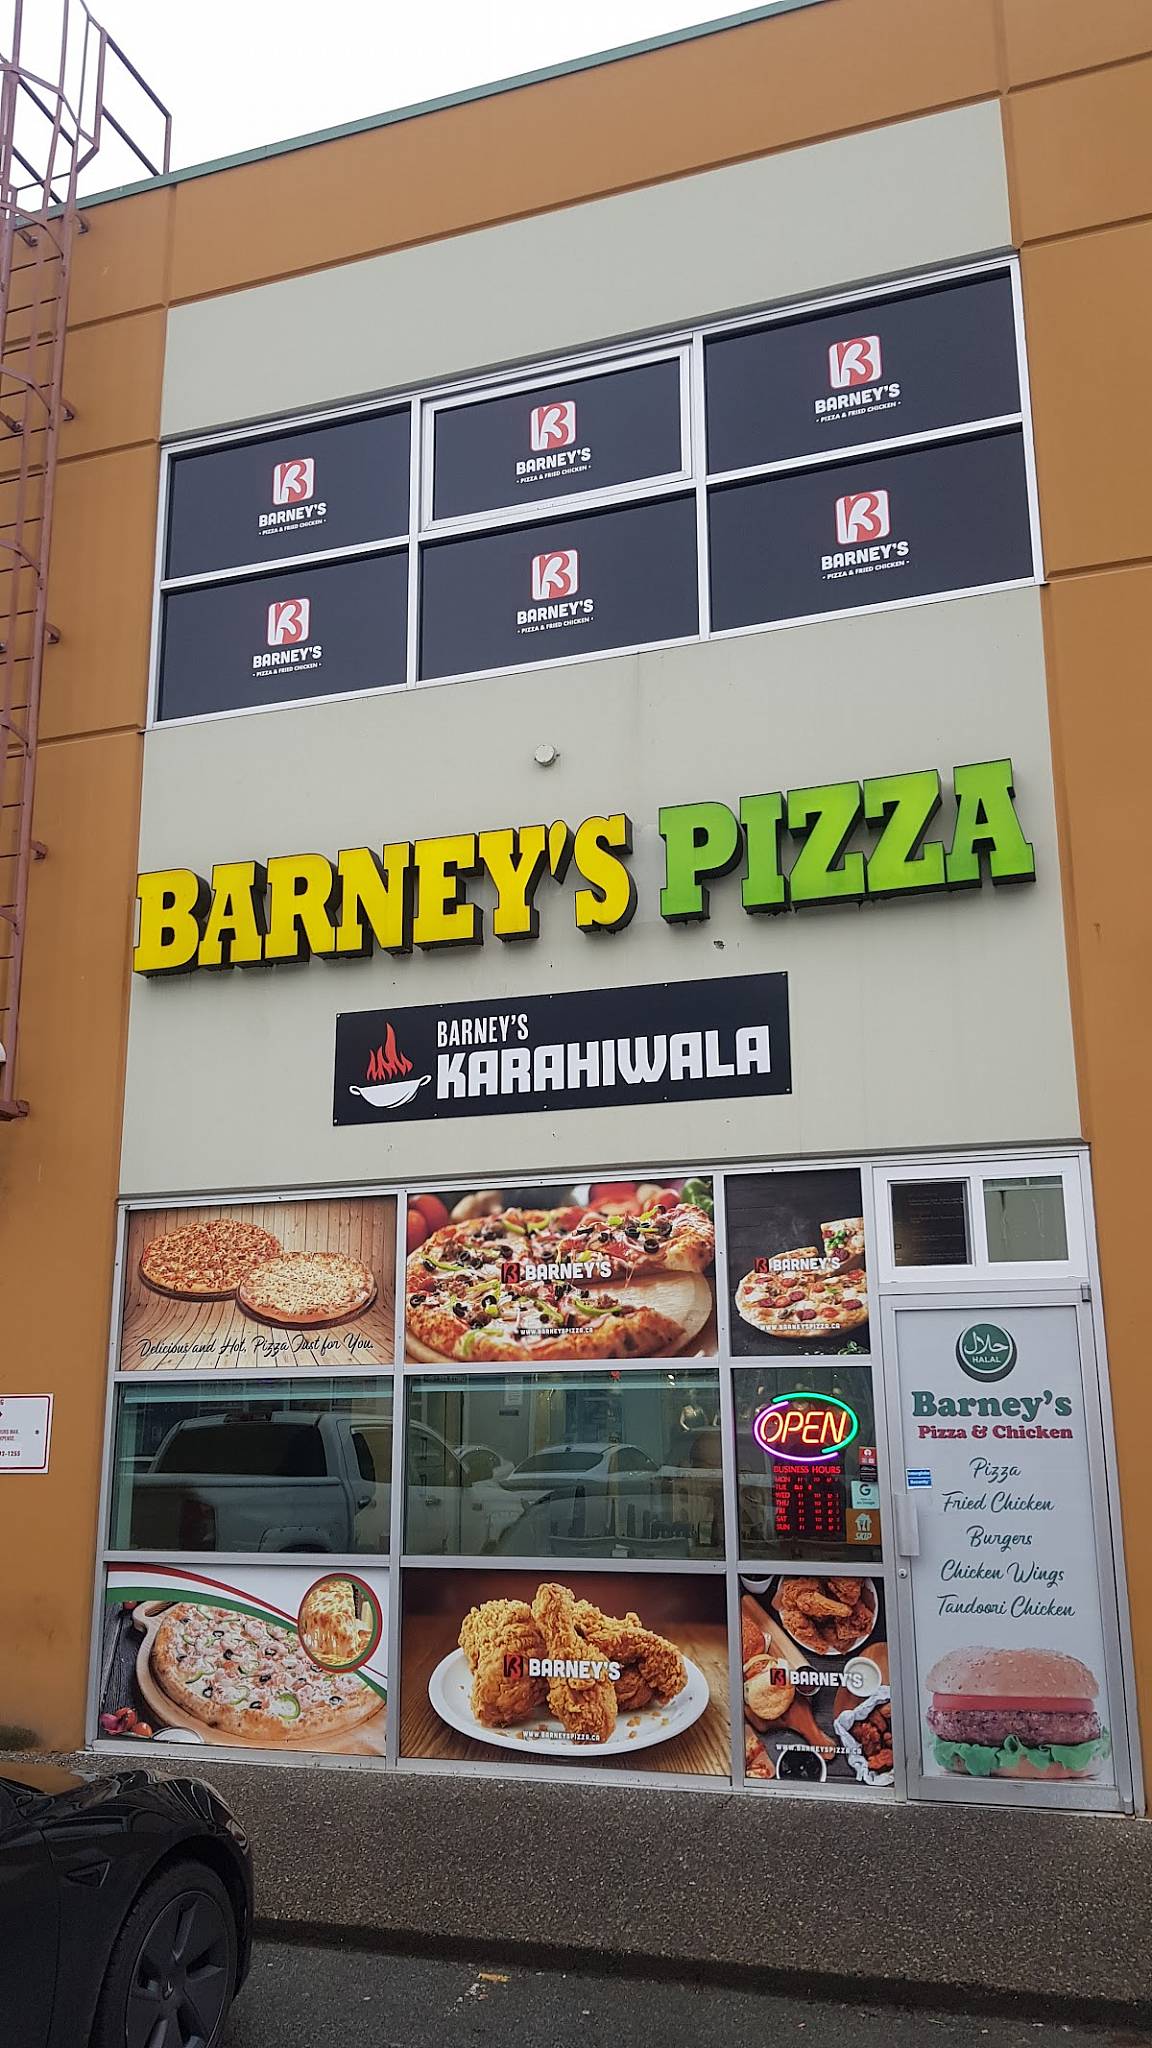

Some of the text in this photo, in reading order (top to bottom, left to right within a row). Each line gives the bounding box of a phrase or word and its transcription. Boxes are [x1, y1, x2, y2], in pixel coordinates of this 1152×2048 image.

[814, 383, 901, 414] BARNEY'S
[820, 414, 840, 423] PIZZA
[847, 408, 866, 417] FRIED
[866, 402, 896, 412] CHICKEN
[516, 447, 591, 475] BARNEY'S
[520, 476, 538, 484] PIZZA
[561, 465, 588, 475] CHICKEN
[258, 502, 327, 528] BARNEY'S
[262, 528, 279, 536] PIZZA
[299, 519, 323, 528] CHICKEN
[821, 541, 909, 571] BARNEY'S
[826, 571, 848, 580] PIZZA
[855, 566, 874, 574] FRIED
[874, 560, 905, 571] CHICKEN
[516, 598, 594, 625] BARNEY'S
[521, 625, 539, 634] PIZZA
[545, 622, 562, 630] FRIED
[563, 617, 590, 626] CHICKEN
[252, 645, 322, 669] BARNEY'S
[294, 663, 318, 671] CHICKEN
[133, 759, 1036, 974] BARNEY'S PIZZA
[436, 1013, 529, 1048] BARNEY'S
[436, 1025, 771, 1100] KARAHIWALA
[525, 1261, 612, 1280] BARNEY'S
[772, 1257, 841, 1272] BARNEY'S
[135, 1338, 189, 1357] Delicious
[191, 1338, 217, 1353] and
[251, 1335, 290, 1358] Pizza
[291, 1334, 321, 1353] Just
[320, 1332, 341, 1357] for
[343, 1332, 374, 1355] You.
[964, 1331, 1009, 1355] حلال
[972, 1356, 1001, 1364] HALAL
[911, 1389, 1073, 1423] Barney's
[760, 1410, 847, 1444] OPEN
[918, 1425, 1073, 1439] Pizza & Chicken
[773, 1465, 841, 1474] BUSINESS HOURS
[969, 1456, 1021, 1484] Pizza
[941, 1490, 1055, 1513] Fried Chicken
[966, 1525, 1033, 1553] Burgers
[940, 1559, 1065, 1588] Chicken Wings
[936, 1594, 1075, 1618] Tandoori Chicken
[528, 1658, 621, 1681] BARNEY'S
[789, 1671, 863, 1688] BARNEY'S
[522, 1730, 600, 1742] WWW.BARNEYSPIZZA.CA
